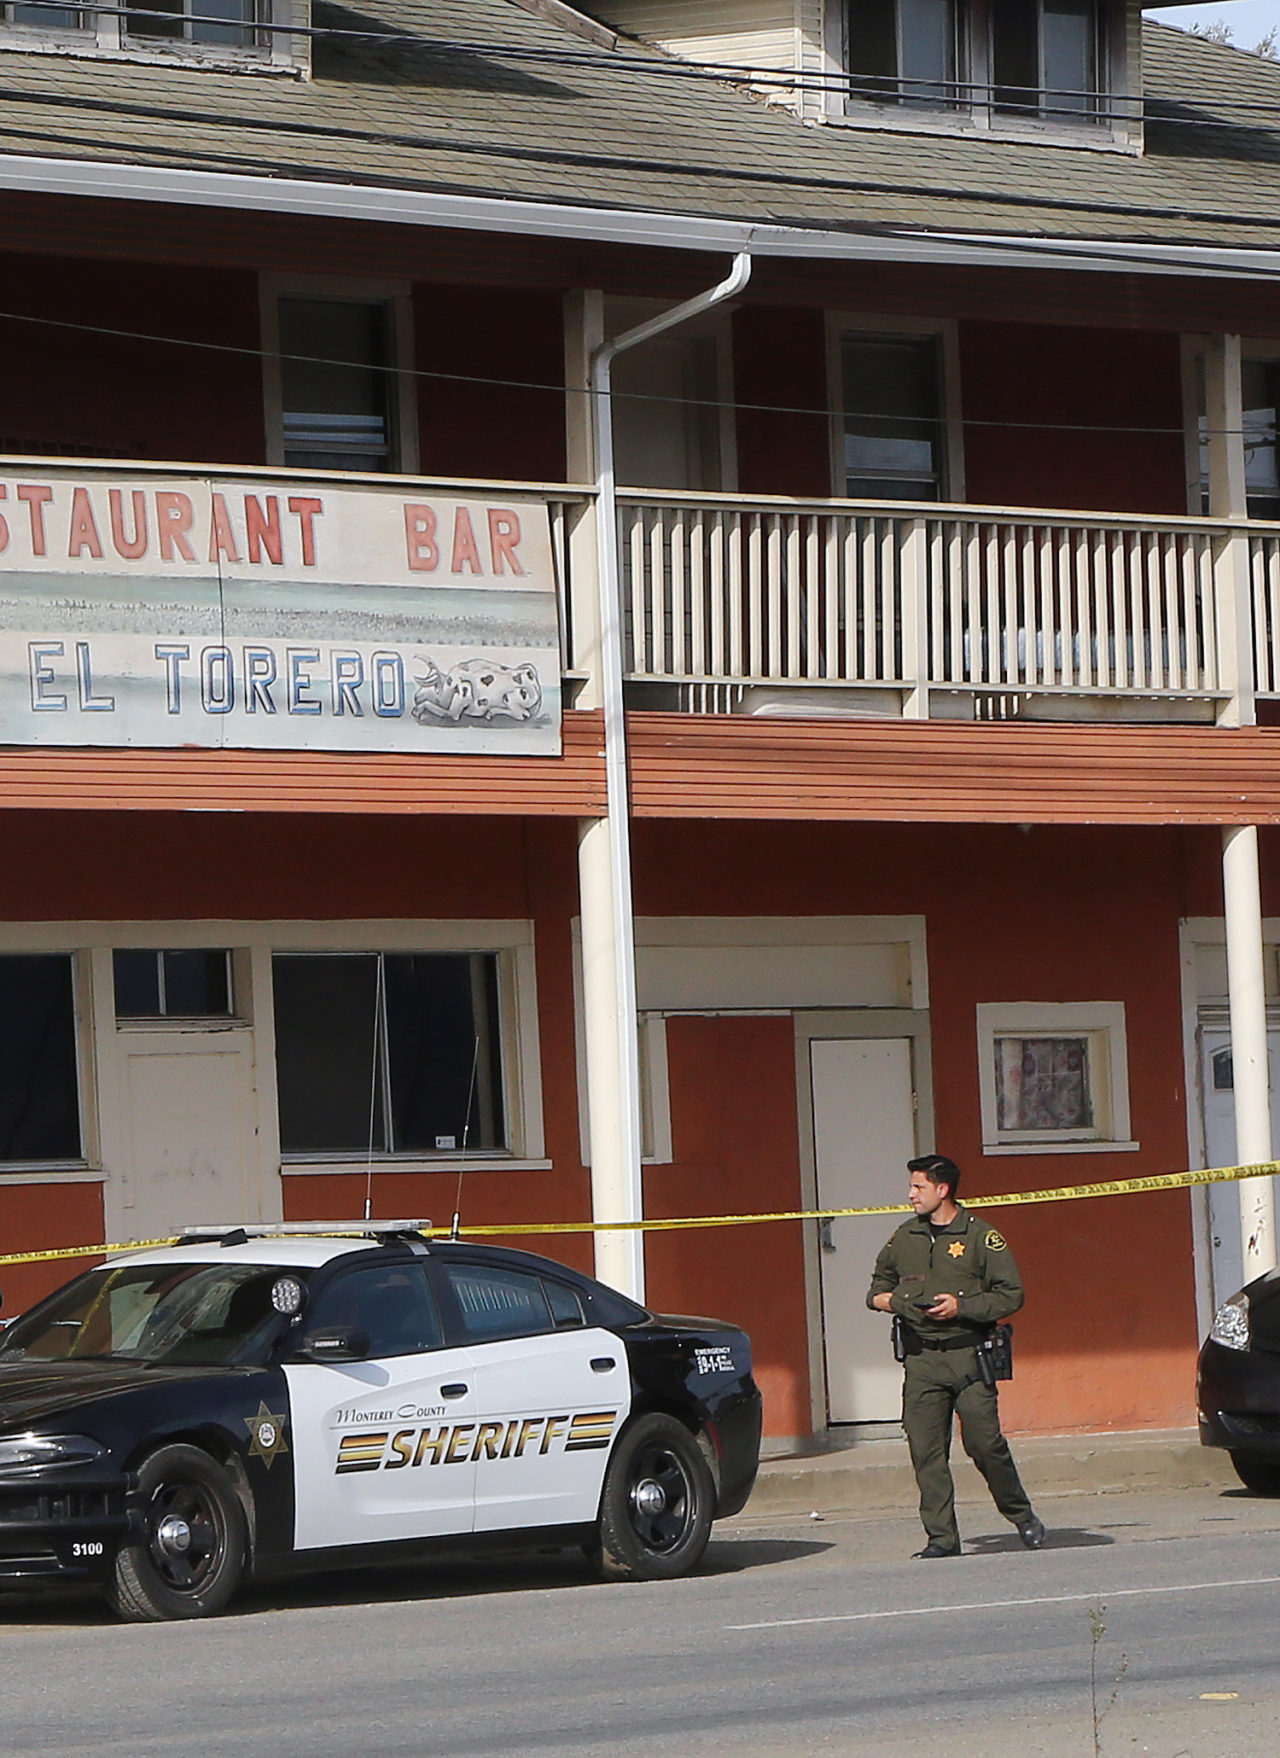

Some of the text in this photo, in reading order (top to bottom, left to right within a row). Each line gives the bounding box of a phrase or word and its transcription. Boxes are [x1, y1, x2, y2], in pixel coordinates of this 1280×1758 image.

[403, 503, 524, 576] BAR
[28, 640, 406, 719] EL TORERO
[384, 1415, 570, 1470] SHERIFF
[72, 1542, 103, 1556] 3100
